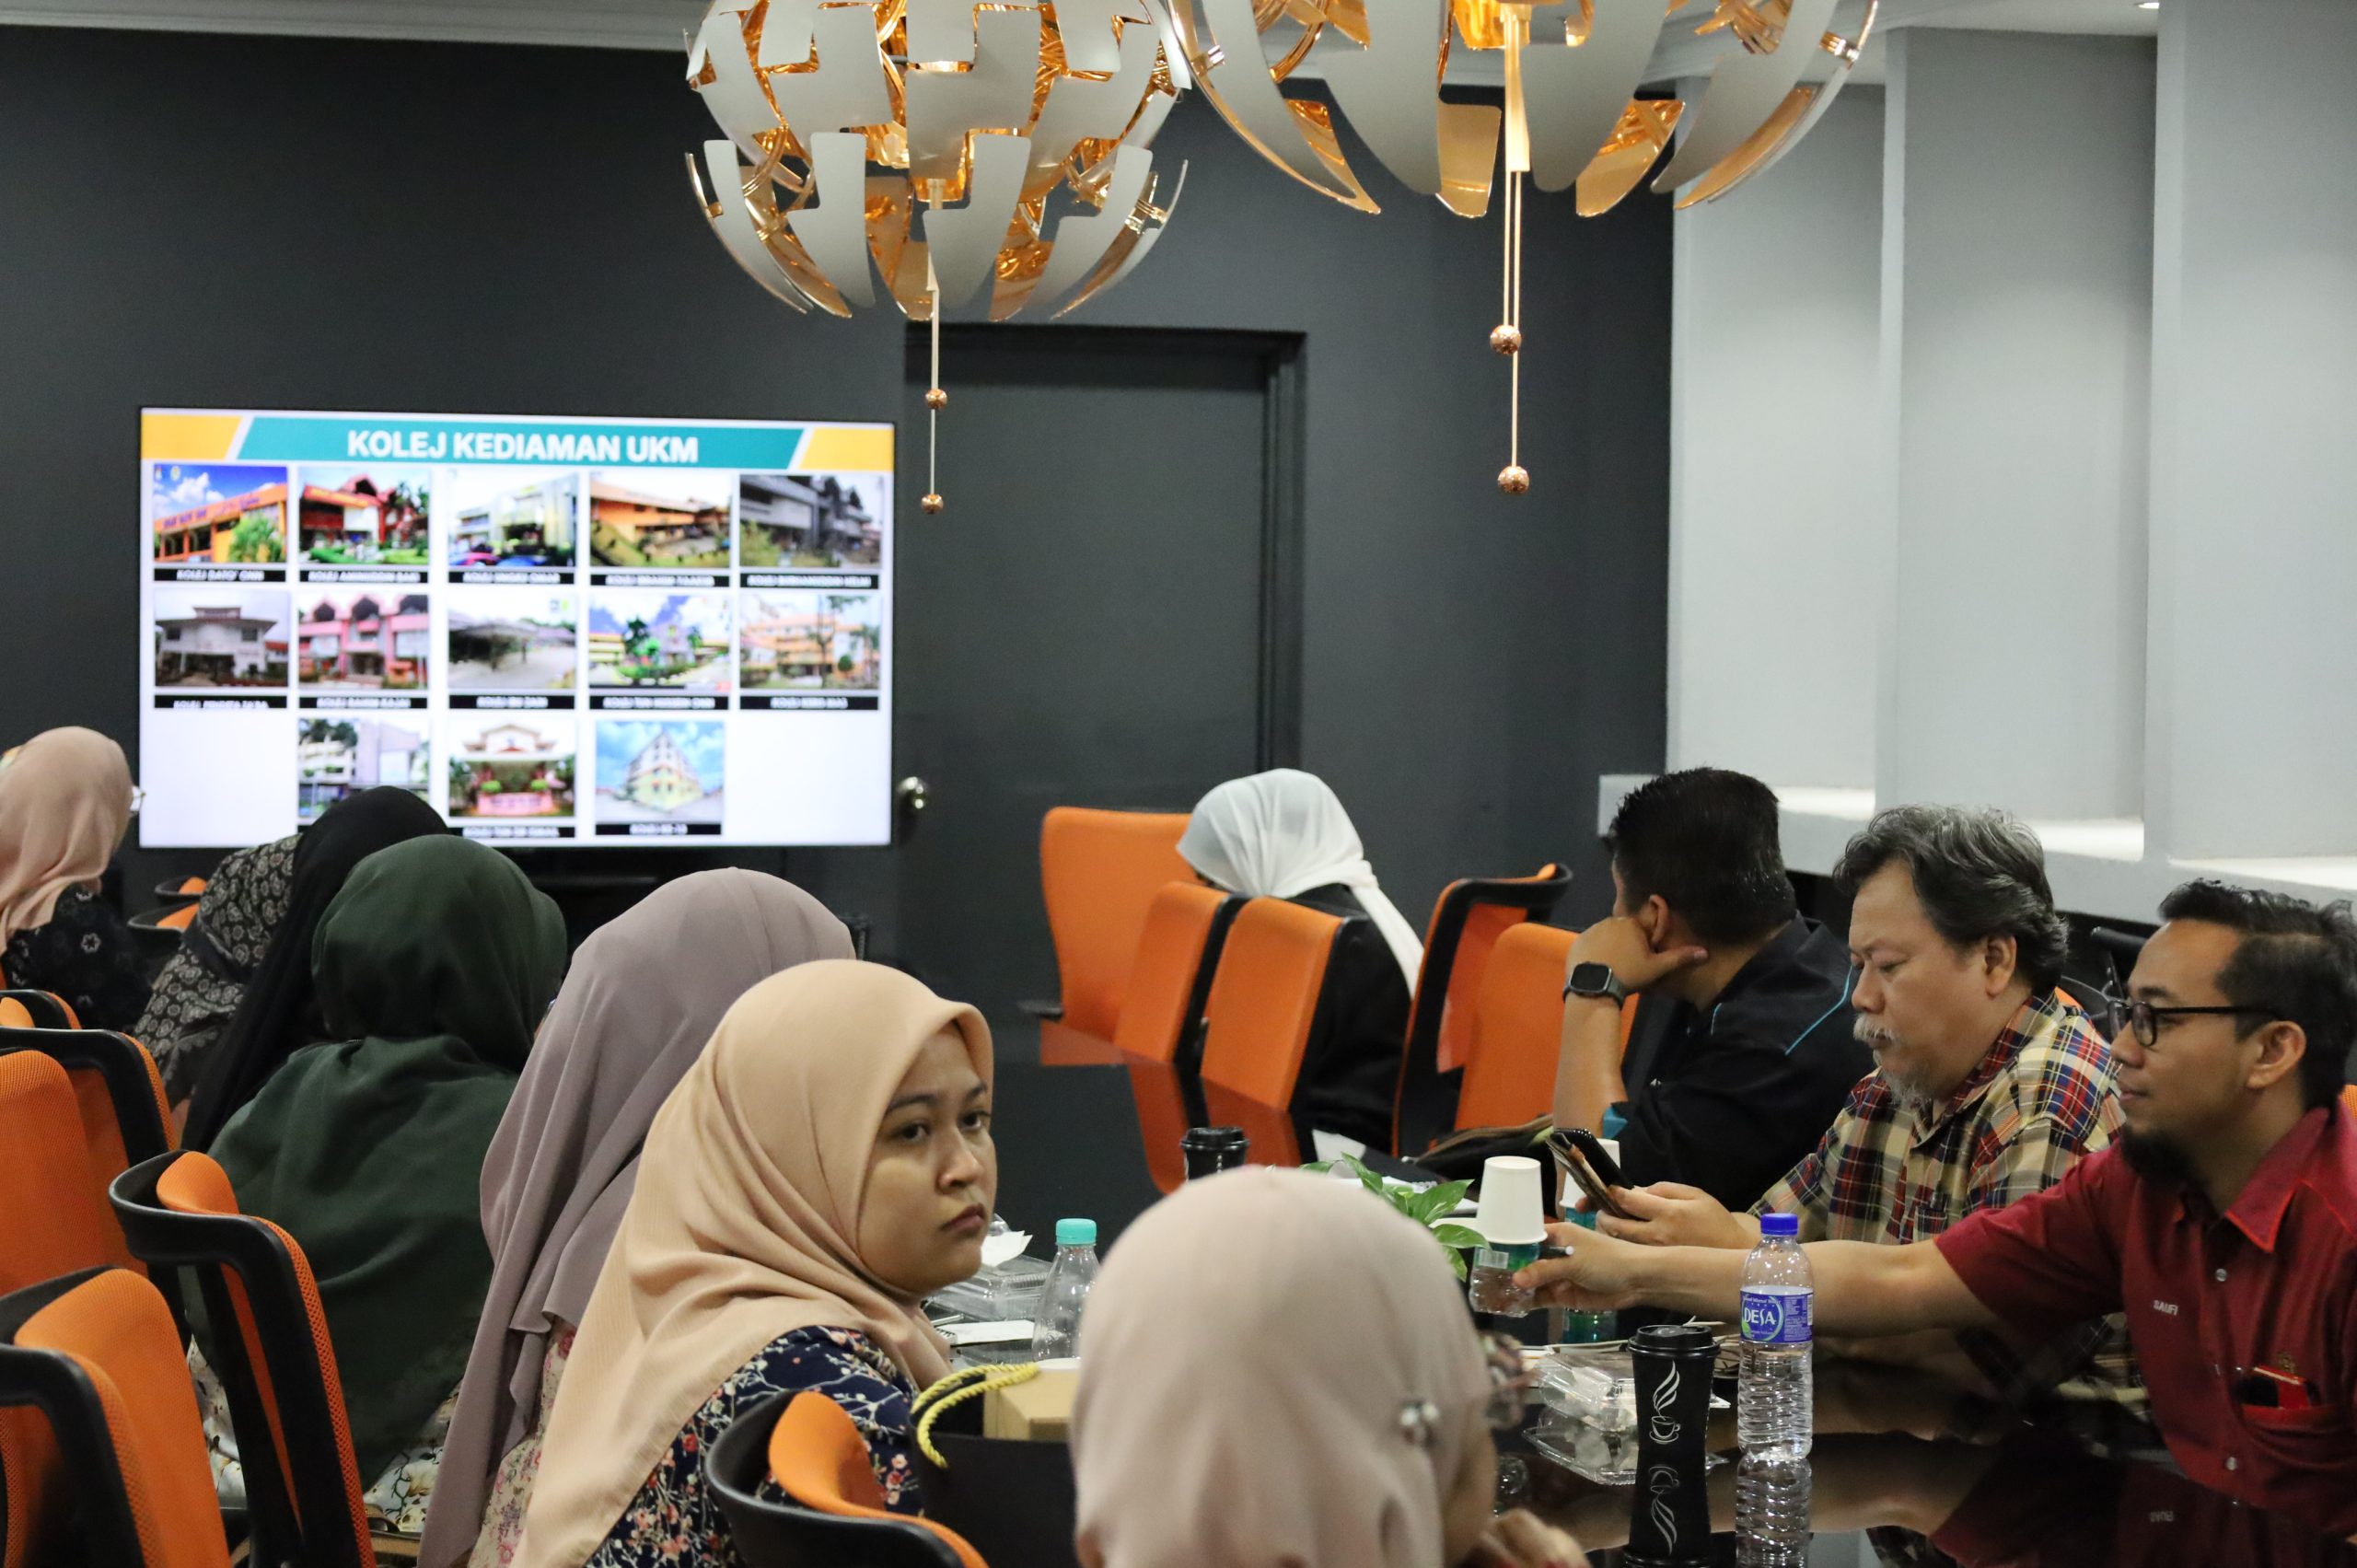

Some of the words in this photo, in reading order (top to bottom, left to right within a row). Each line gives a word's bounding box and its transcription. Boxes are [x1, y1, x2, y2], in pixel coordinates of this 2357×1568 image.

[348, 431, 447, 458] KOLEJ
[454, 433, 620, 460] KEDIAMAN
[627, 436, 699, 462] UKM
[1744, 1307, 1777, 1326] DESA
